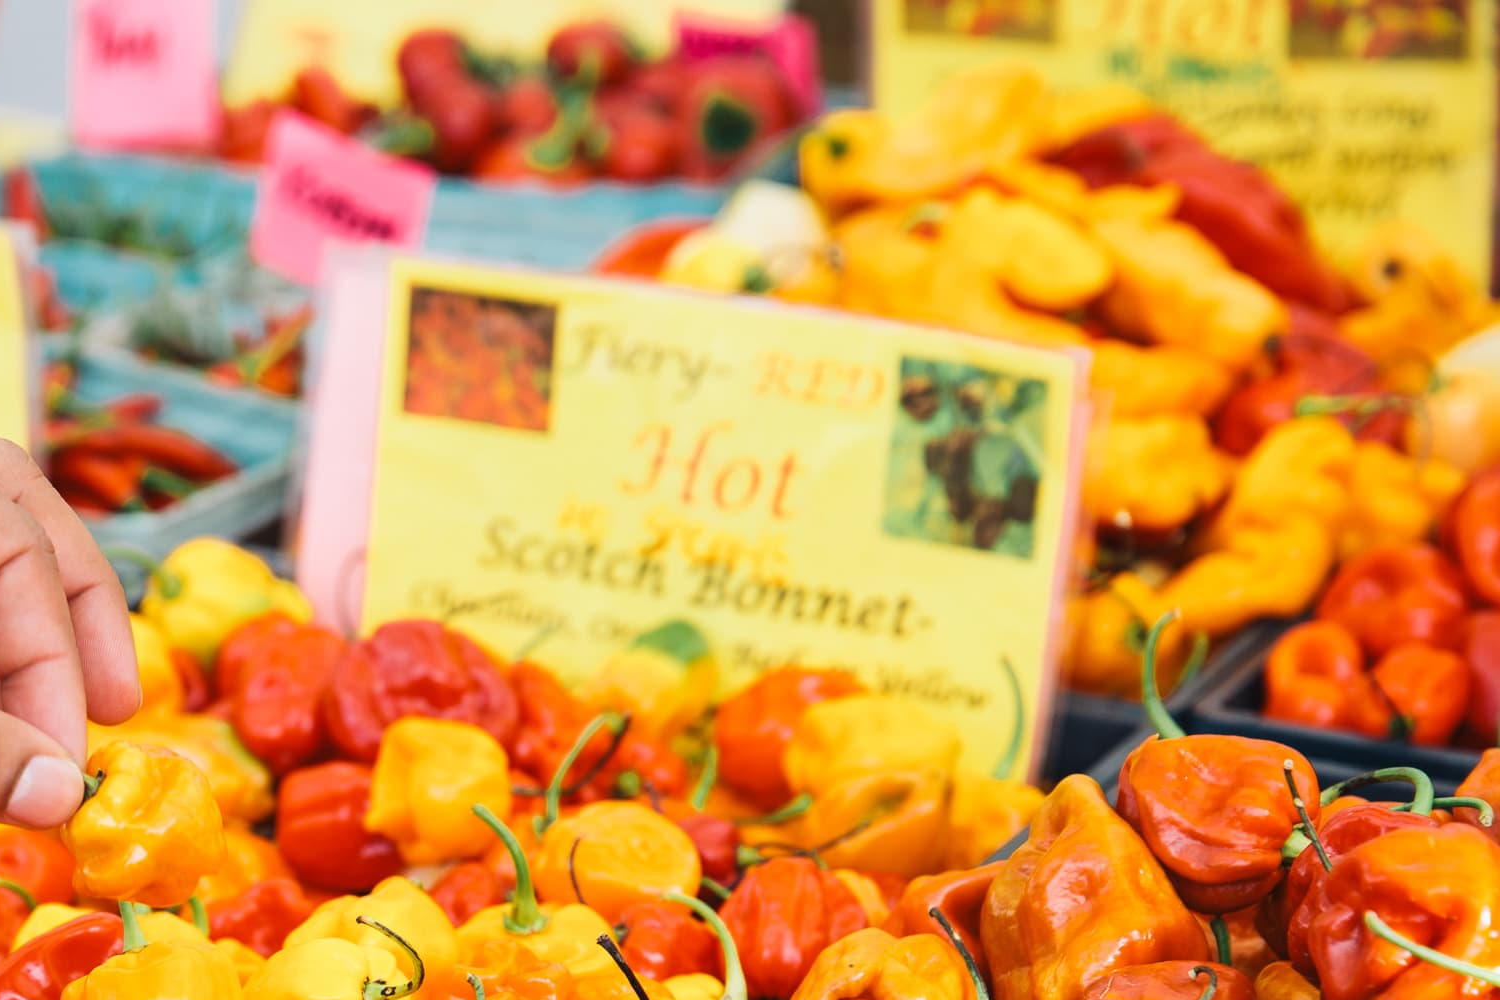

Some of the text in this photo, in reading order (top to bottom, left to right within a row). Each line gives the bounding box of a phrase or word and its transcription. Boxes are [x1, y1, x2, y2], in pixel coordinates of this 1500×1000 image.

[754, 350, 886, 410] RED
[616, 419, 800, 518] Hot
[478, 512, 666, 597] Scotch
